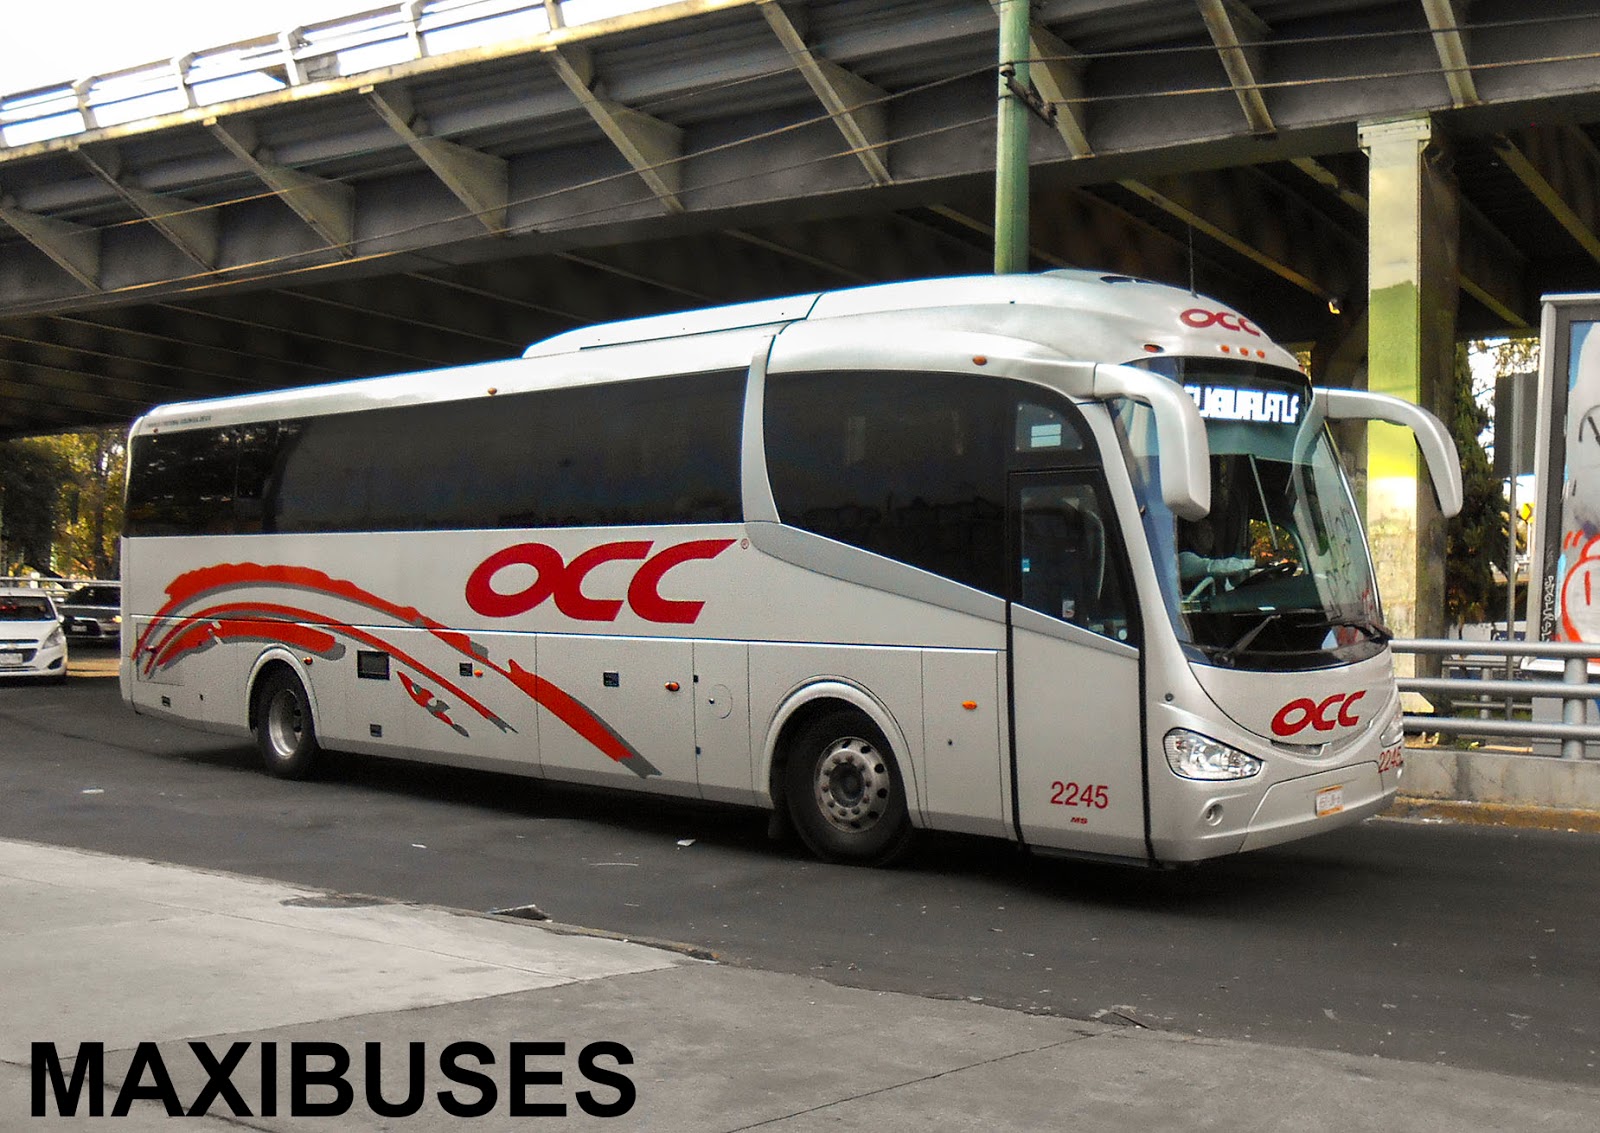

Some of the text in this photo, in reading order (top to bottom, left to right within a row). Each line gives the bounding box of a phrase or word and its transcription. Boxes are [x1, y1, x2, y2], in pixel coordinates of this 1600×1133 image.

[1180, 309, 1260, 335] OCC
[466, 538, 735, 624] OCC
[1271, 690, 1367, 737] OCC
[1050, 780, 1109, 810] 2245
